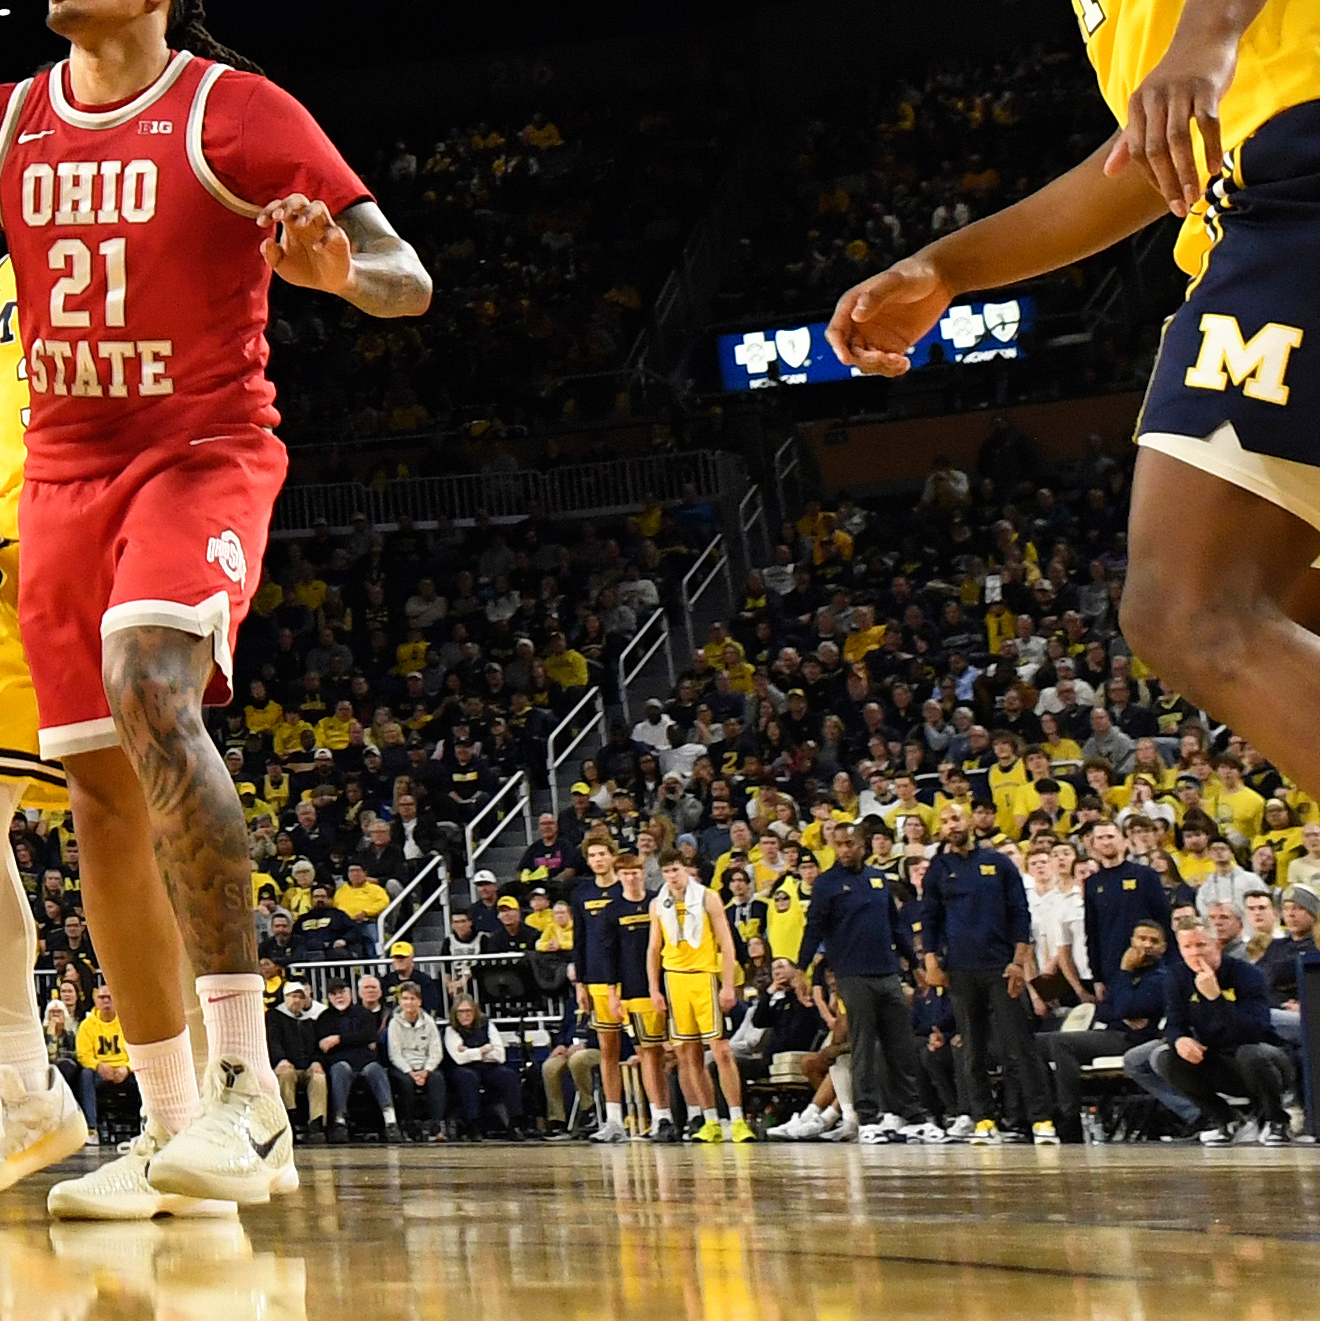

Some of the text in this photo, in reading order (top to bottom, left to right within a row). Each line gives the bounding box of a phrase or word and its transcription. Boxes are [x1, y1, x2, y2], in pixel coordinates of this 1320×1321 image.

[21, 159, 159, 228] OHIO
[47, 236, 127, 329] 21
[29, 337, 175, 399] STATE
[1184, 312, 1305, 407] M
